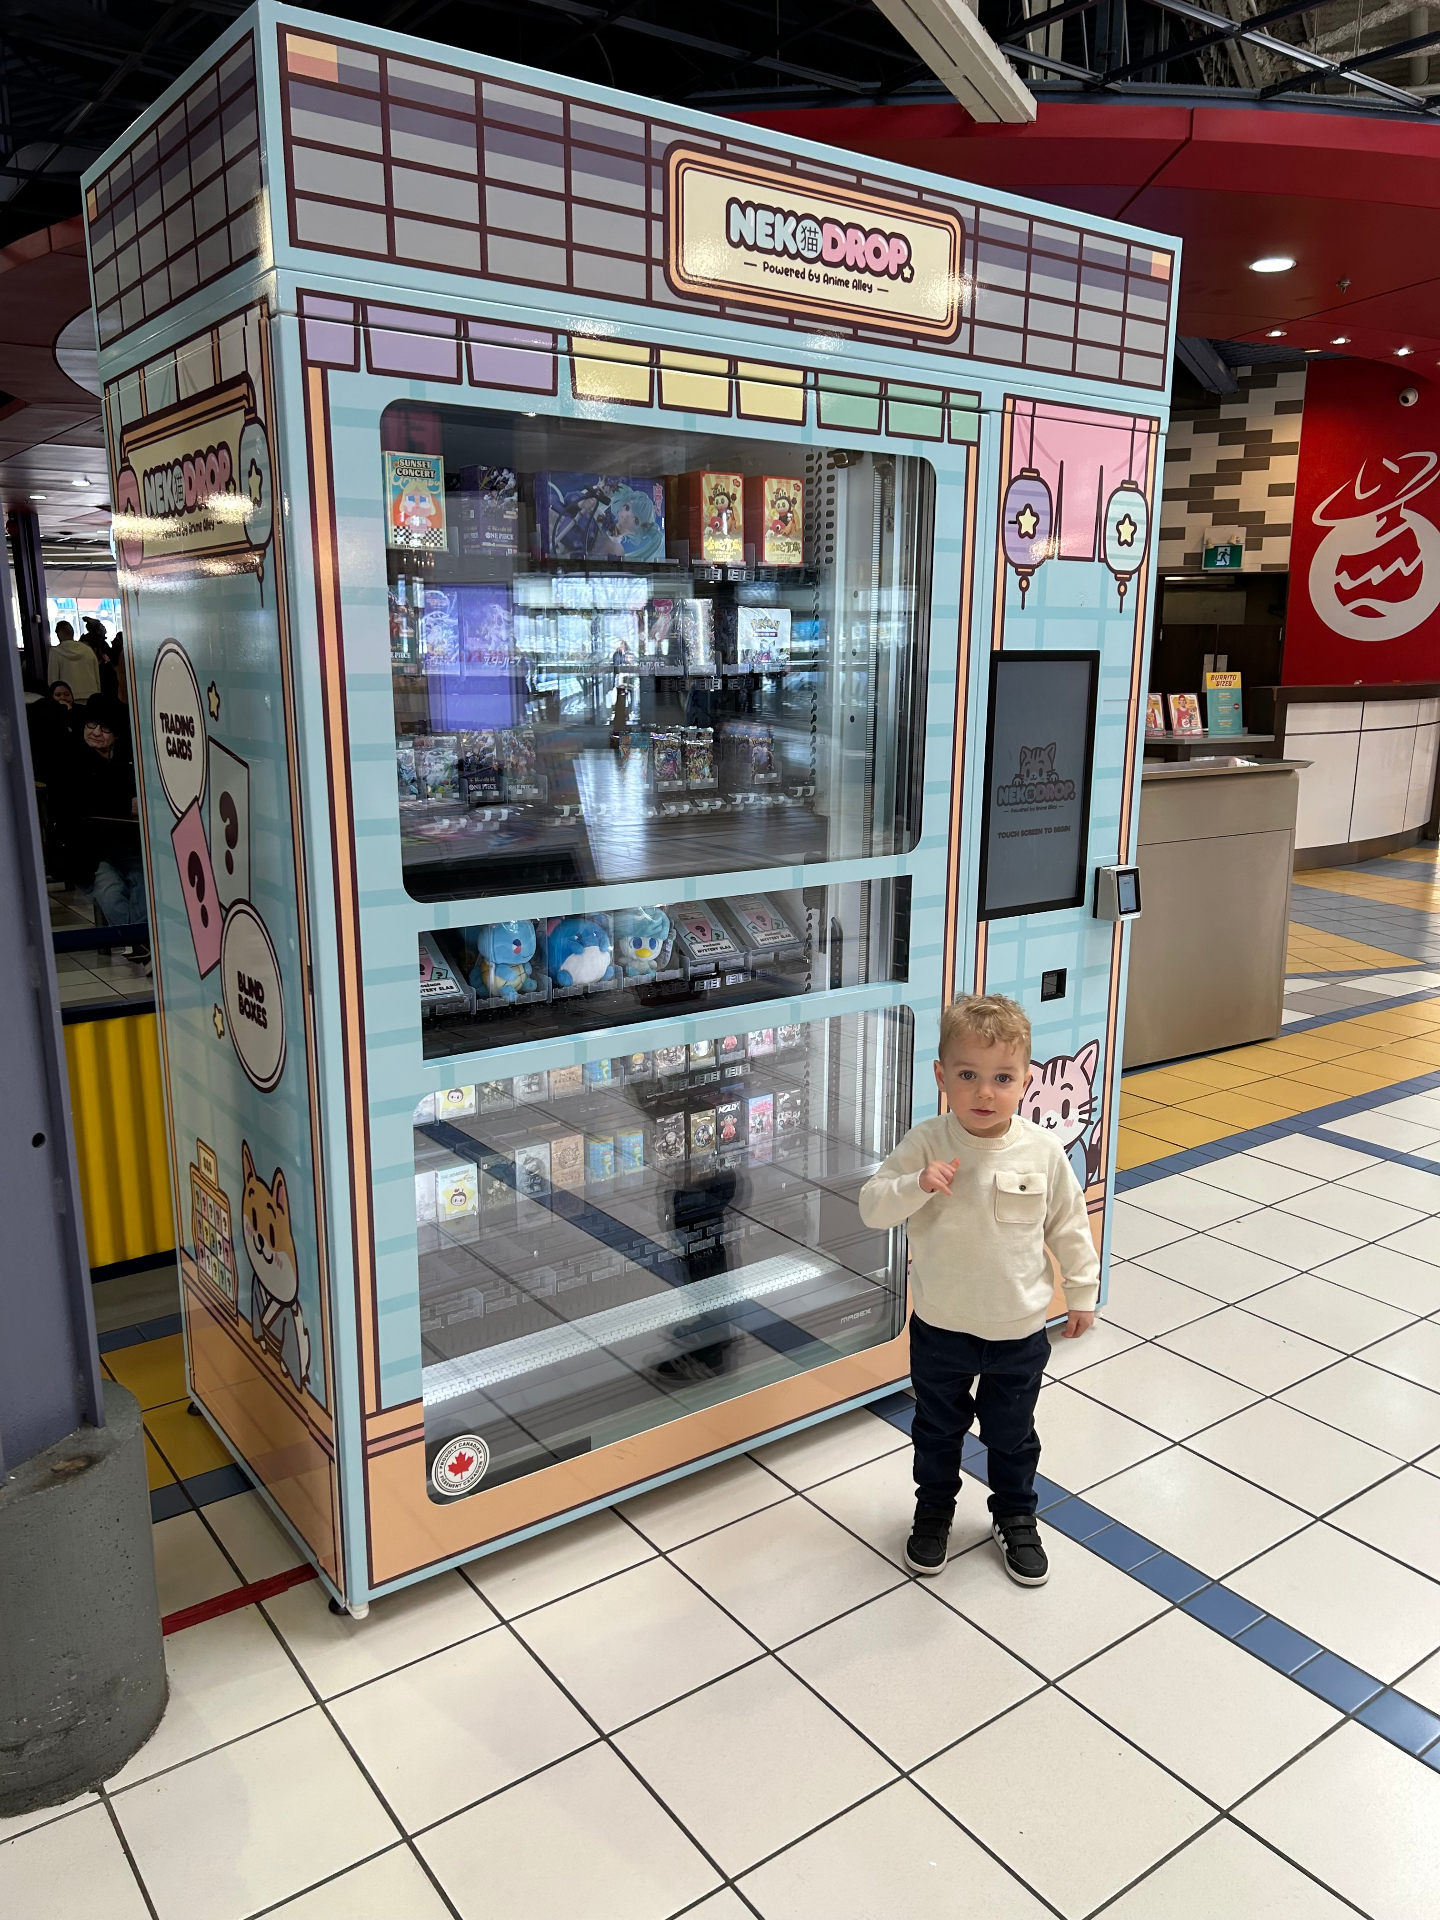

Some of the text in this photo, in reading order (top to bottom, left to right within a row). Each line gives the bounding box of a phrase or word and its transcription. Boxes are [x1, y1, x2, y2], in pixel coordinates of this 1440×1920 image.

[763, 262, 873, 293] Powered by Anime Alley
[396, 468, 435, 479] CONCERT
[399, 458, 432, 469] SUNSET
[160, 712, 195, 738] TRADING
[166, 737, 193, 761] CARDS
[998, 831, 1020, 839] TOUCH
[1021, 828, 1043, 837] SCREEN
[1054, 825, 1071, 833] BEGIN
[697, 945, 718, 954] MYSTERY
[237, 971, 264, 1004] BLIND
[238, 993, 268, 1030] BOXES
[440, 1441, 482, 1469] PROUDLY CANADIAN
